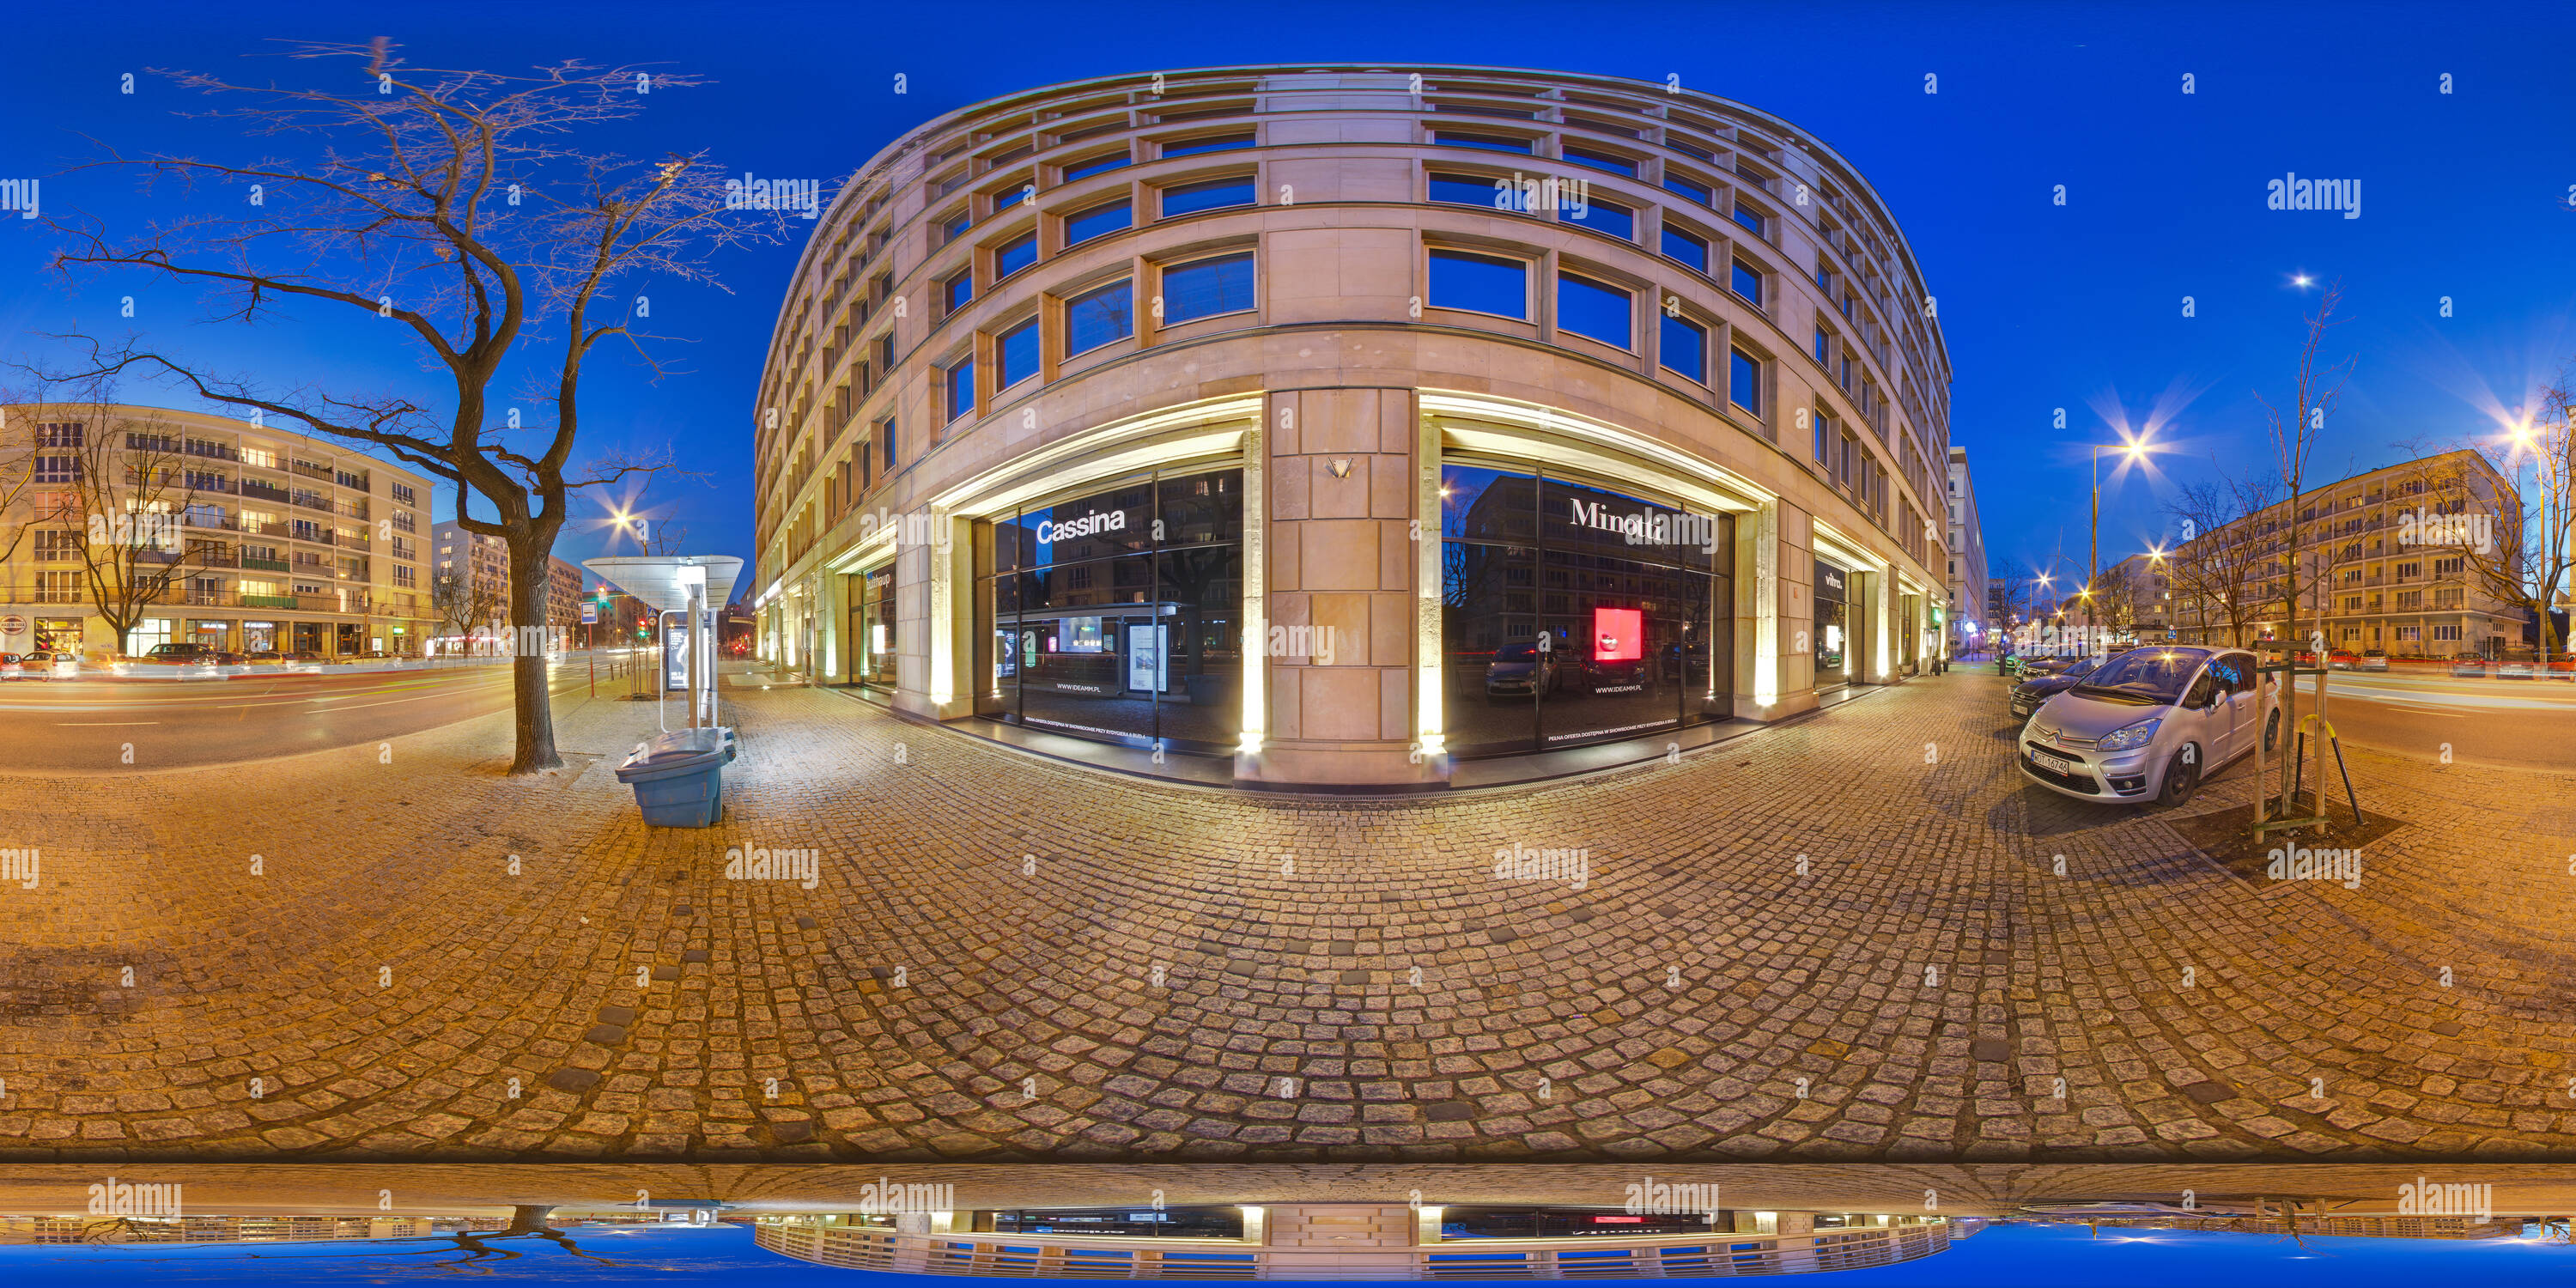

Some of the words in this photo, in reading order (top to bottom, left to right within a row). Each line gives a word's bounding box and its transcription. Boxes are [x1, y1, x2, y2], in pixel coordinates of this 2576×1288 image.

[1037, 509, 1125, 544] Cassina
[1570, 498, 1662, 540] Minotti
[1595, 684, 1642, 694] WWW.IDEAMM.PL
[2047, 758, 2067, 772] 16746
